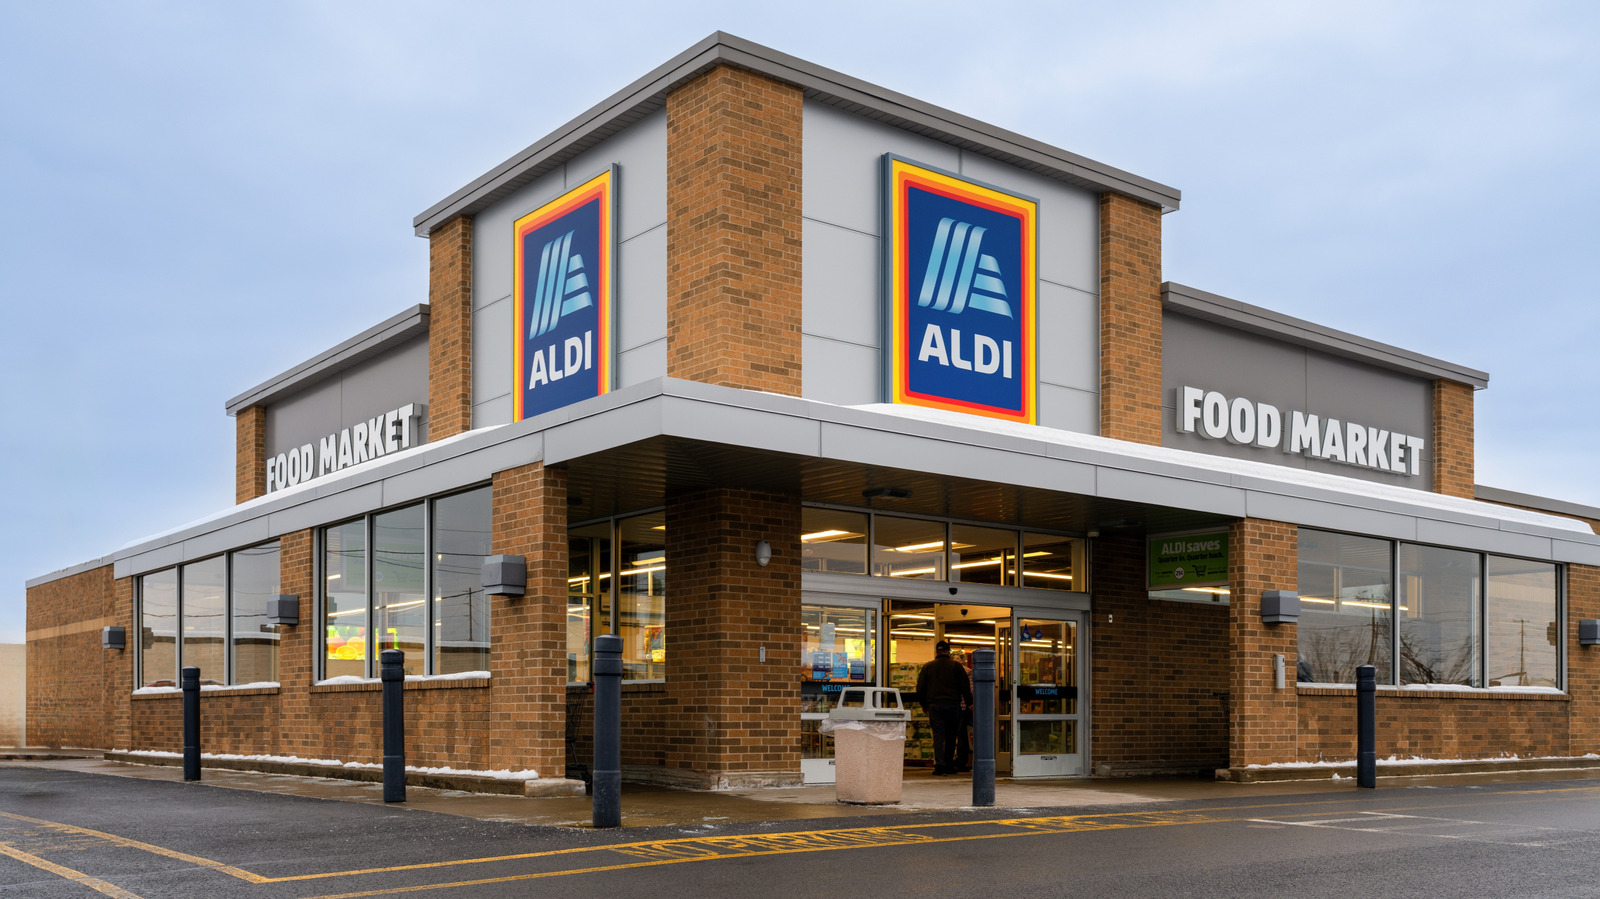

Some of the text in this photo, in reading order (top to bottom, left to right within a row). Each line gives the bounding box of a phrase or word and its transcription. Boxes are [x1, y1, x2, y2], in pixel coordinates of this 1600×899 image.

[529, 330, 592, 390] ALDI
[918, 323, 1012, 379] ALDI
[266, 402, 416, 494] FOOD MARKET
[1181, 385, 1424, 477] FOOD MARKET
[1157, 555, 1178, 564] Quarter
[1187, 552, 1209, 562] Quarter
[1161, 540, 1221, 555] ALDI saves
